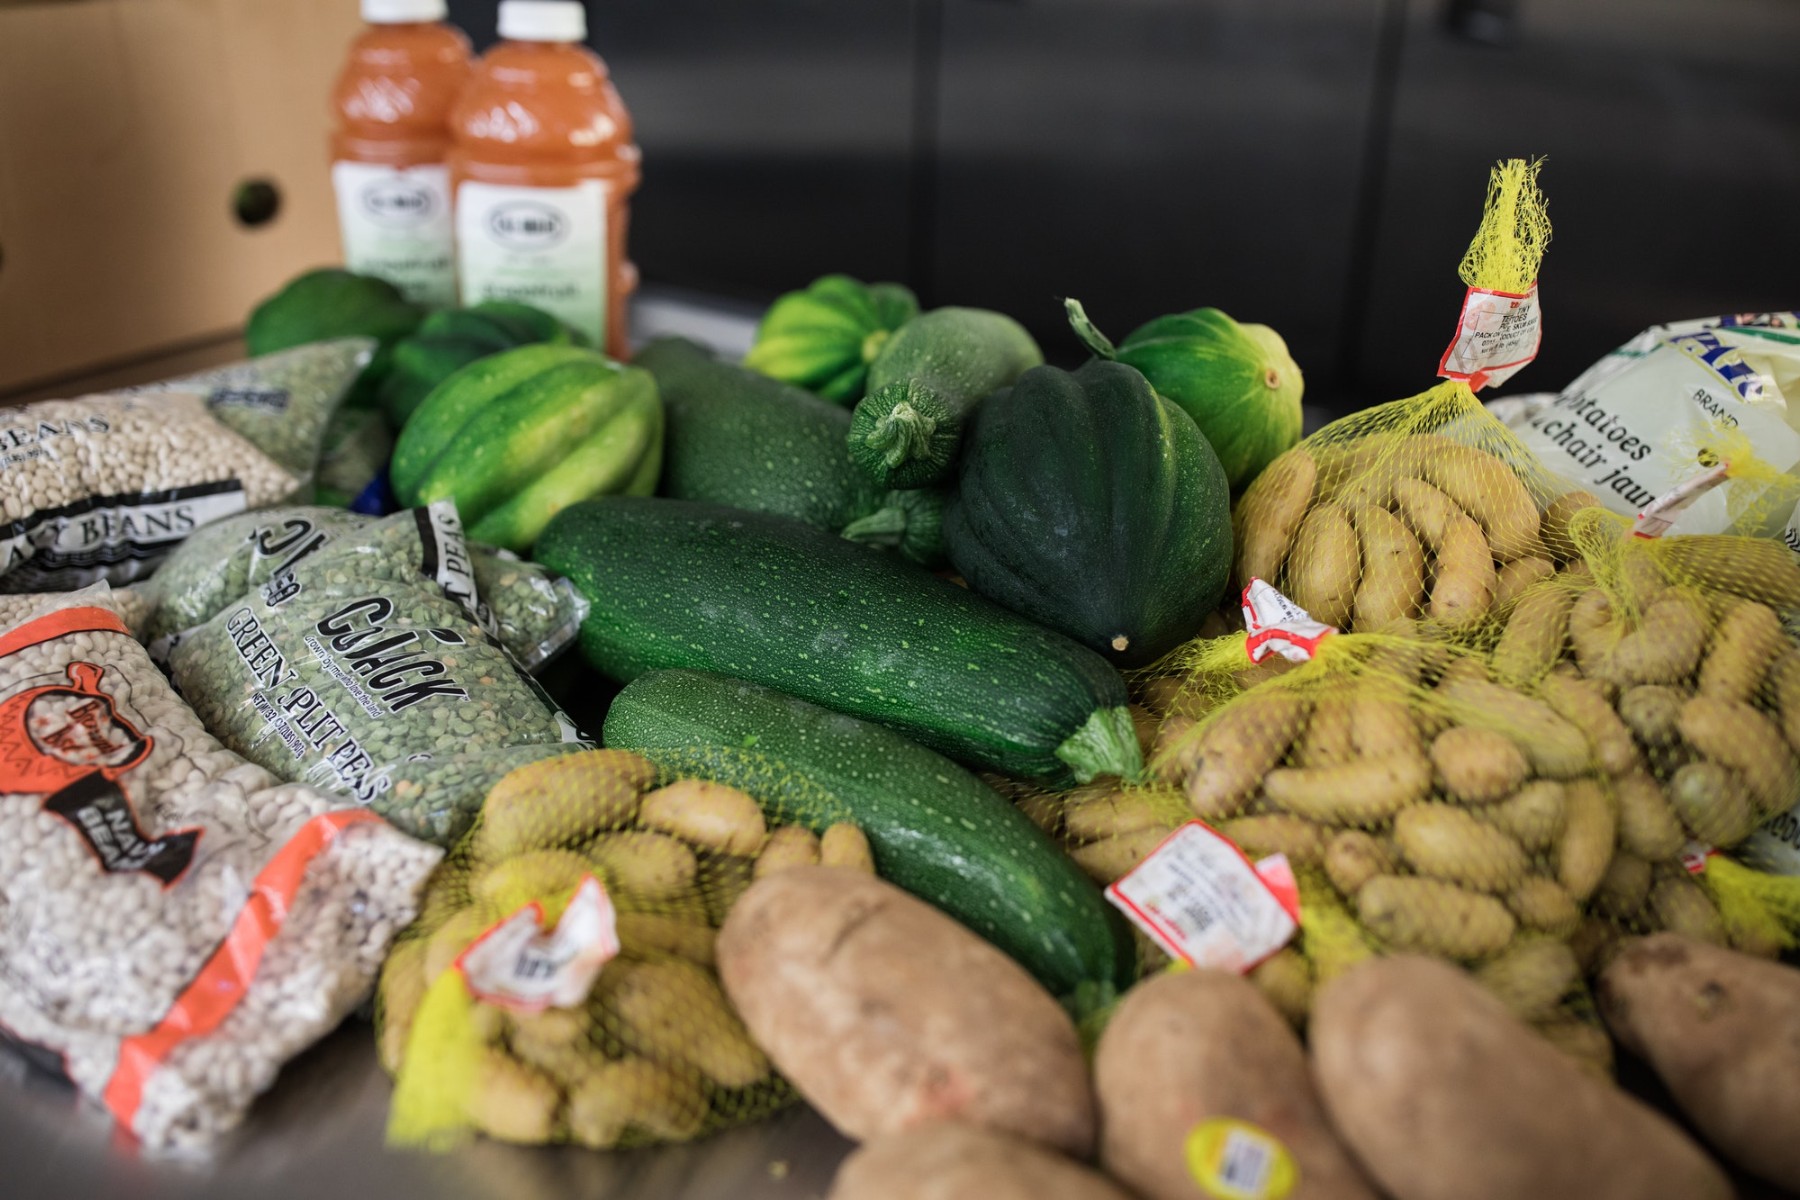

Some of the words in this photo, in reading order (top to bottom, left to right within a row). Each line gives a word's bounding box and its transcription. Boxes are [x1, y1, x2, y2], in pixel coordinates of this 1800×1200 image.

[1693, 389, 1738, 430] BRAND
[1543, 420, 1607, 468] chair
[1594, 465, 1655, 508] jau
[81, 505, 195, 545] BEANS
[228, 608, 296, 689] GREEN
[252, 692, 265, 706] NET
[265, 709, 277, 721] 32
[359, 693, 371, 705] the
[366, 703, 383, 717] land
